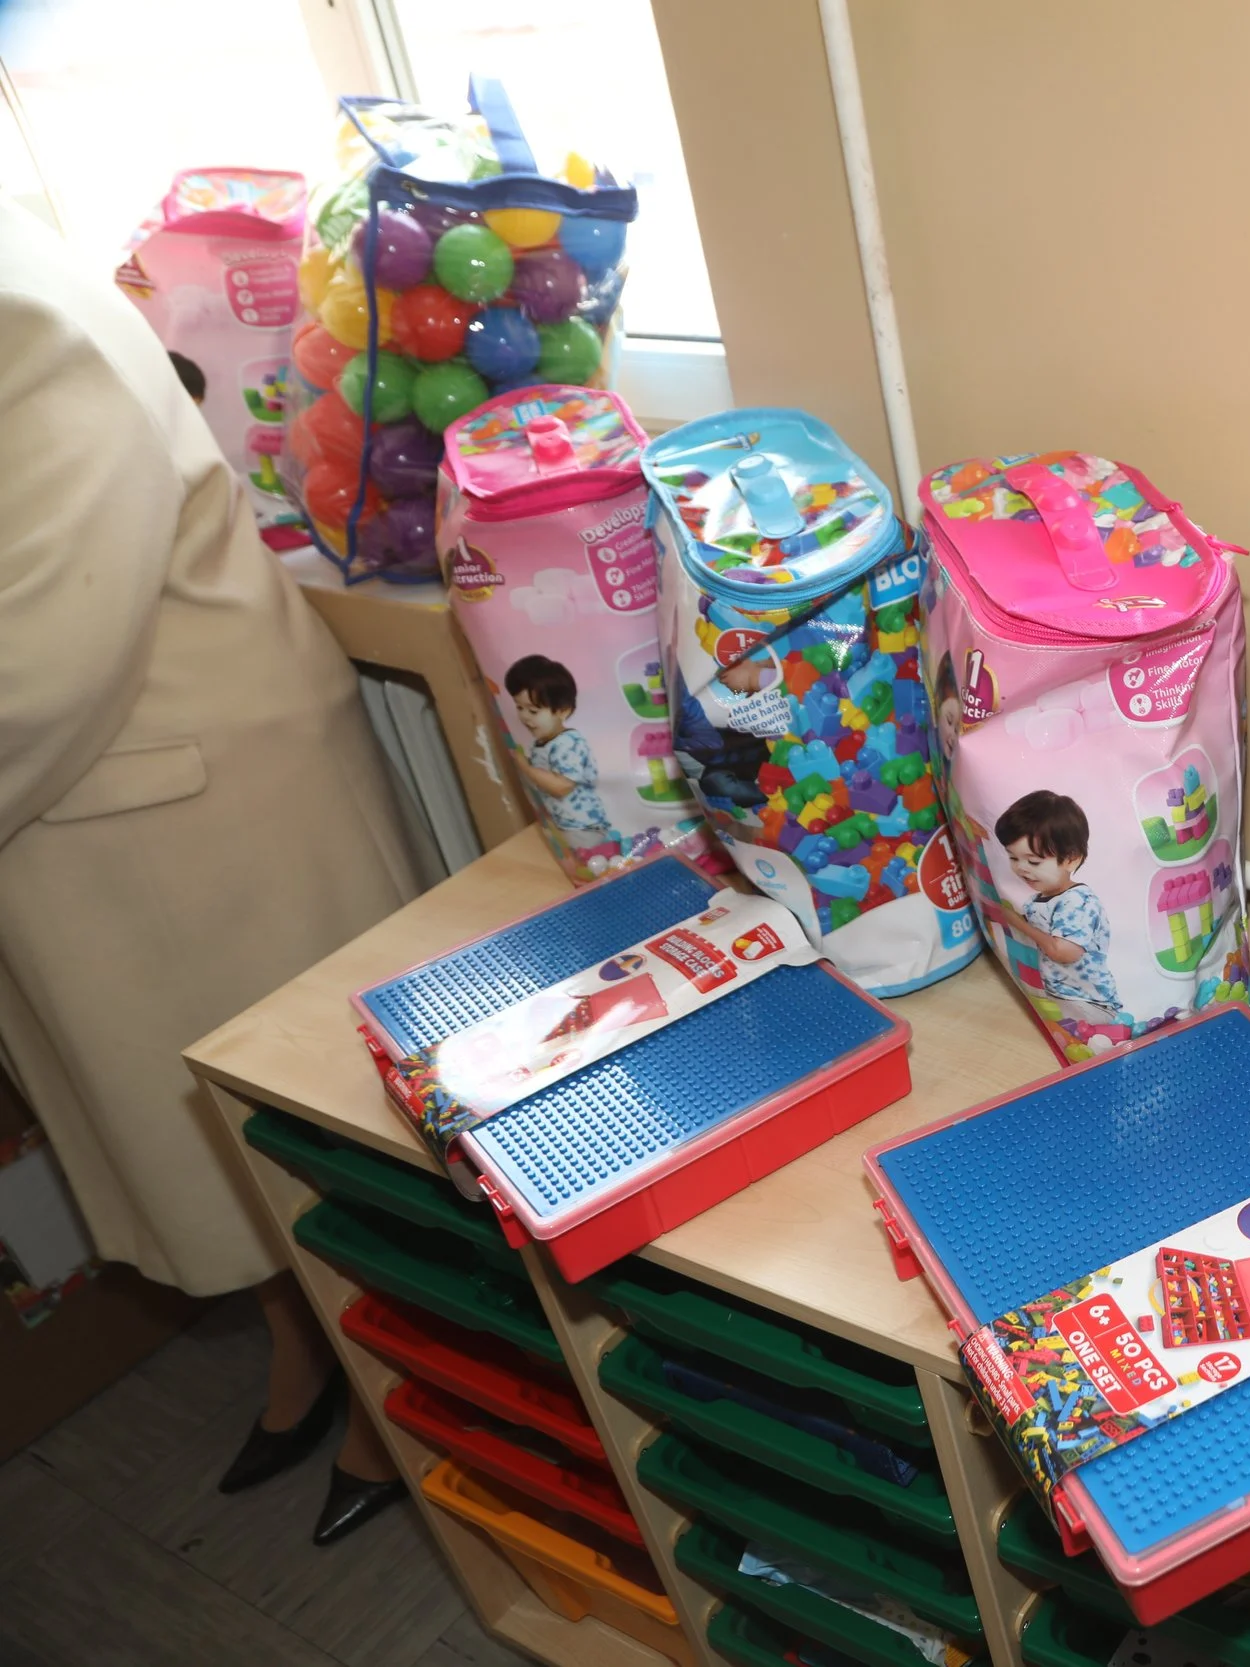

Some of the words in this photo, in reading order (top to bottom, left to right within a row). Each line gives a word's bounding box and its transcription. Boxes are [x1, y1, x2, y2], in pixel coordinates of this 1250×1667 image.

[875, 555, 919, 592] BLO
[735, 632, 757, 648] 1+
[1147, 664, 1170, 678] Fine
[729, 713, 758, 728] little
[759, 699, 789, 717] hands
[732, 699, 762, 717] Made
[763, 690, 779, 702] for
[1155, 695, 1184, 711] Skills
[750, 711, 791, 733] growing
[940, 873, 963, 898] fir
[951, 913, 973, 938] 80
[684, 958, 709, 978] CASE
[692, 946, 725, 979] BLOCKS
[1088, 1304, 1111, 1326] 6+
[1115, 1332, 1142, 1358] 50
[1133, 1357, 1169, 1391] PCS
[971, 1337, 989, 1362] CHOKING
[984, 1358, 1001, 1380] HAZARD
[999, 1380, 1013, 1399] Small
[1007, 1395, 1021, 1415] parts.
[986, 1342, 1014, 1382] WARNING:
[1068, 1330, 1101, 1367] ONE
[1091, 1365, 1122, 1394] SET
[1110, 1348, 1143, 1387] MIXED
[1213, 1355, 1238, 1371] 17
[965, 1343, 974, 1358] Not
[976, 1363, 993, 1386] children
[990, 1382, 1003, 1402] under
[1002, 1404, 1011, 1417] yrs.
